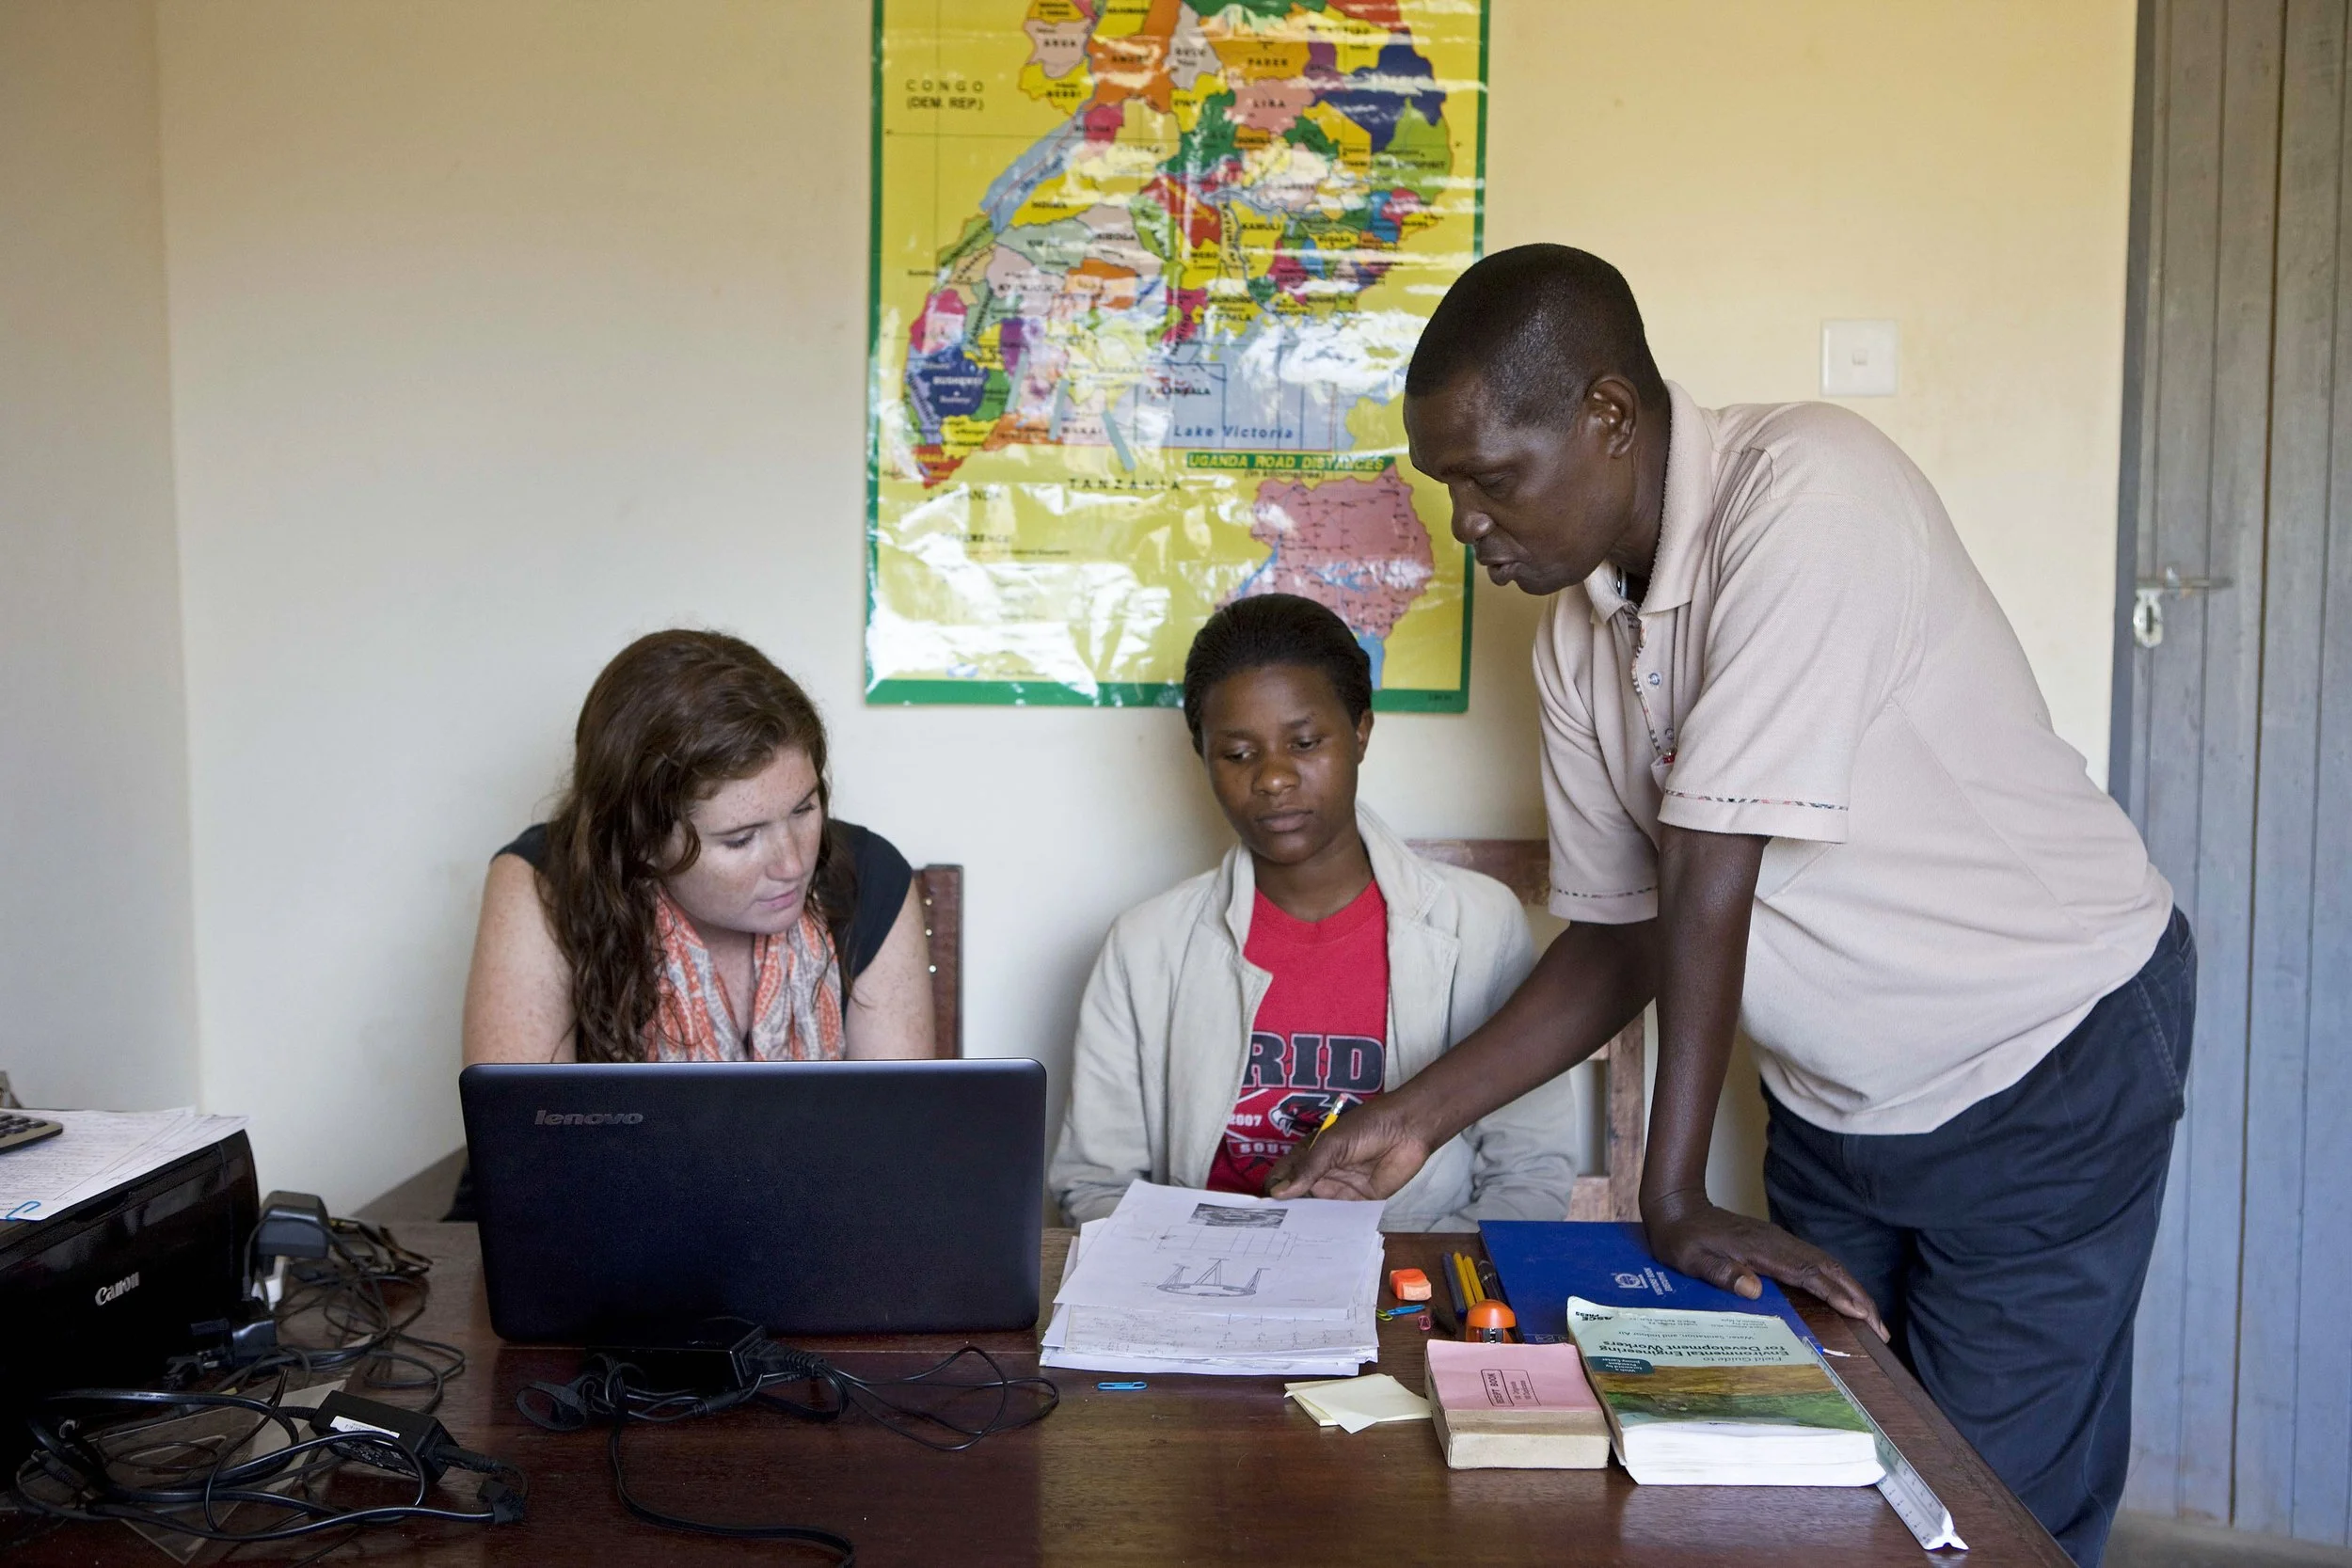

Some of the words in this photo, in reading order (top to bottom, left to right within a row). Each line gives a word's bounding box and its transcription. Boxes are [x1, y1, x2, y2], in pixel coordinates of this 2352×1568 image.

[1173, 425, 1215, 438] Lake
[1222, 425, 1294, 439] Victoria
[1188, 454, 1248, 468] UGANDA
[1253, 455, 1295, 469] ROAD
[1301, 456, 1385, 470] DISTANCES
[534, 1109, 644, 1126] lenovo
[1228, 1113, 1263, 1127] 2007
[95, 1272, 140, 1307] Canon
[1598, 1344, 1683, 1357] Engineering
[1602, 1340, 1664, 1351] Workers
[1665, 1343, 1759, 1353] Development
[1685, 1349, 1789, 1357] Environmental
